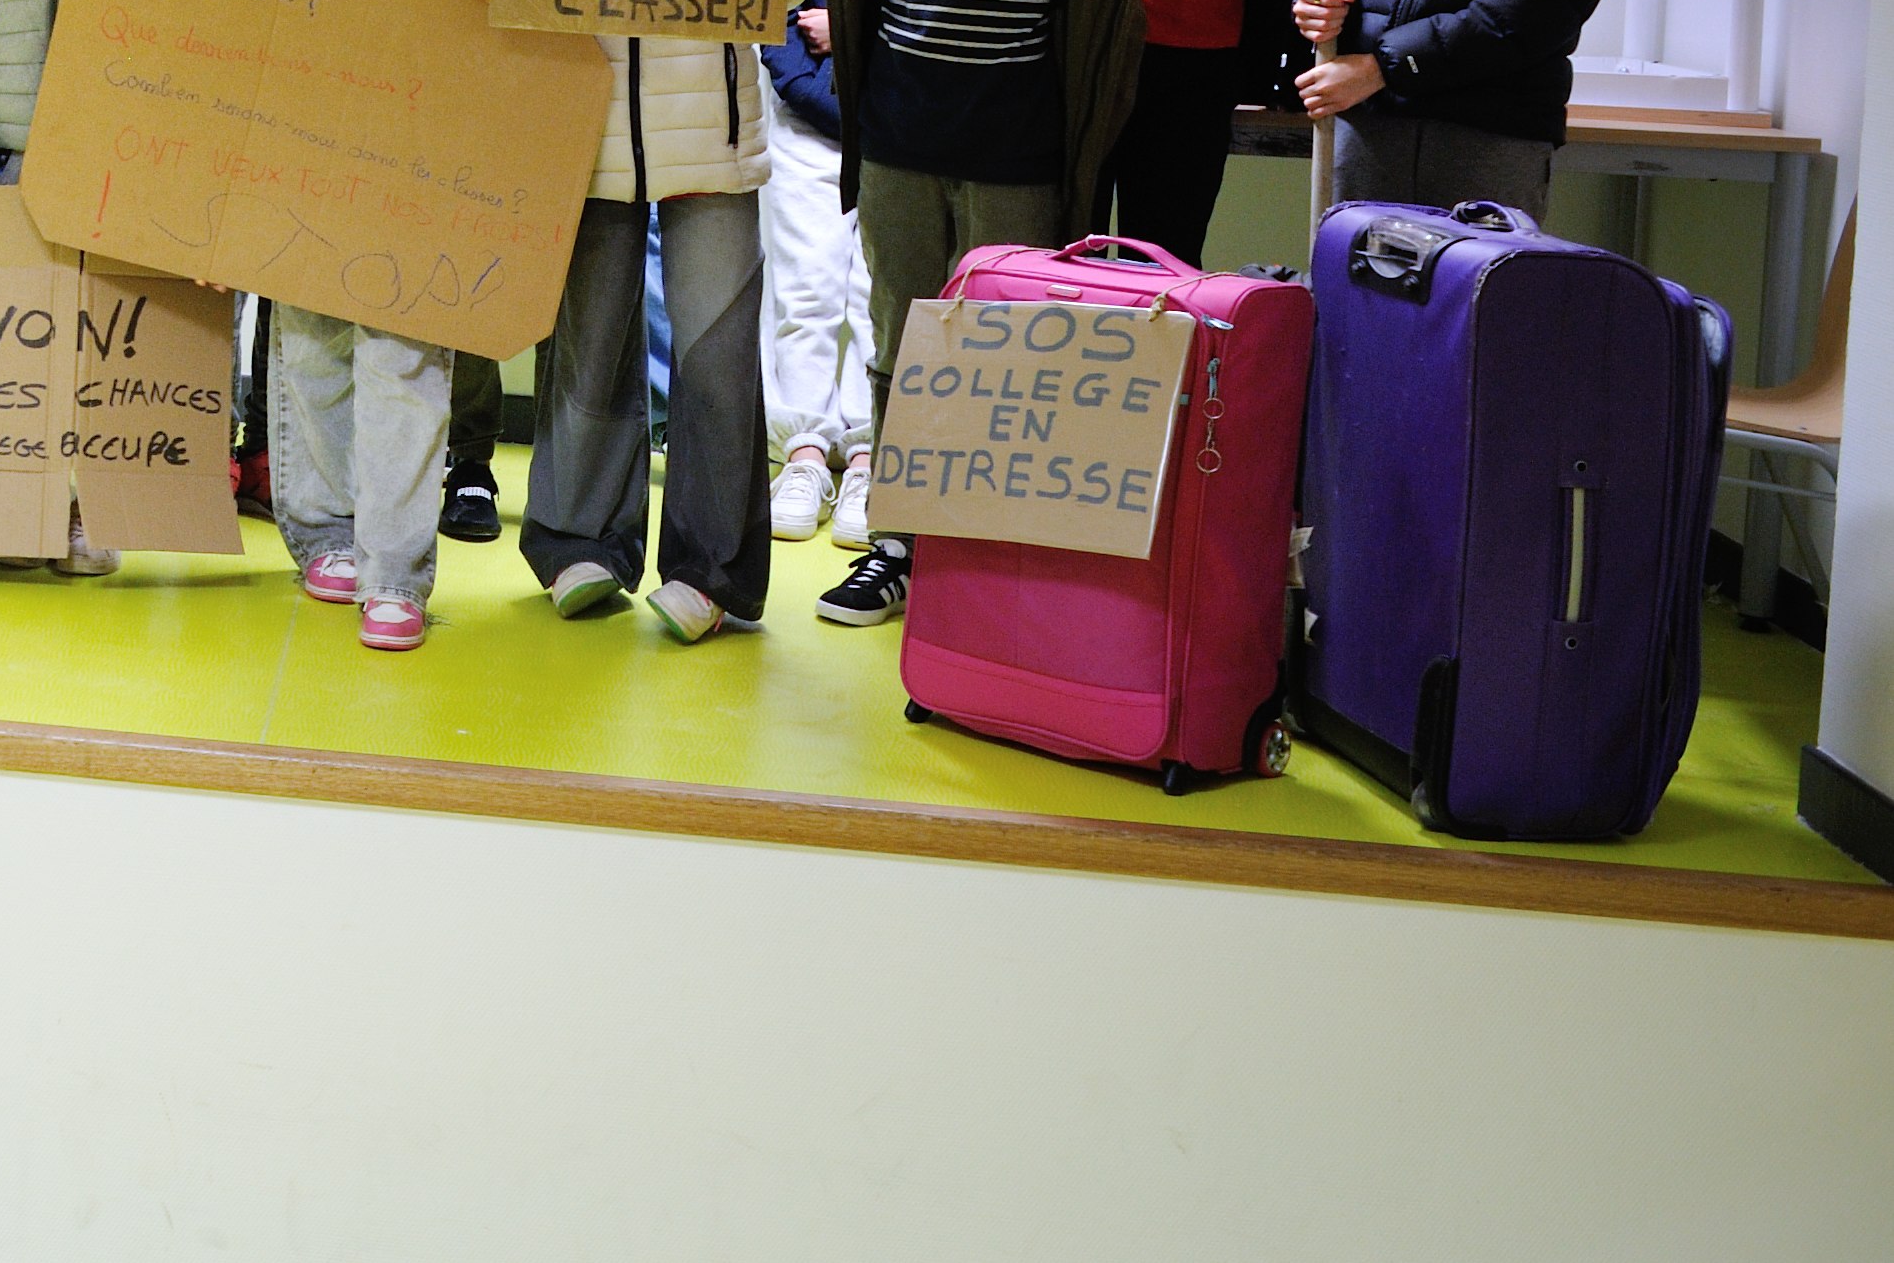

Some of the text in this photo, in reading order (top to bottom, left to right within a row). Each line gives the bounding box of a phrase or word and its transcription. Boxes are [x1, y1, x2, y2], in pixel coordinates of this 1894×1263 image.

[101, 5, 157, 49] Que
[114, 125, 189, 168] ONT
[297, 168, 372, 204] TOUT
[962, 302, 1136, 362] SOS
[74, 378, 223, 415] CHANCES
[899, 364, 1161, 413] COLLEGE
[988, 404, 1056, 442] EN
[877, 444, 1152, 513] DETRESSE
